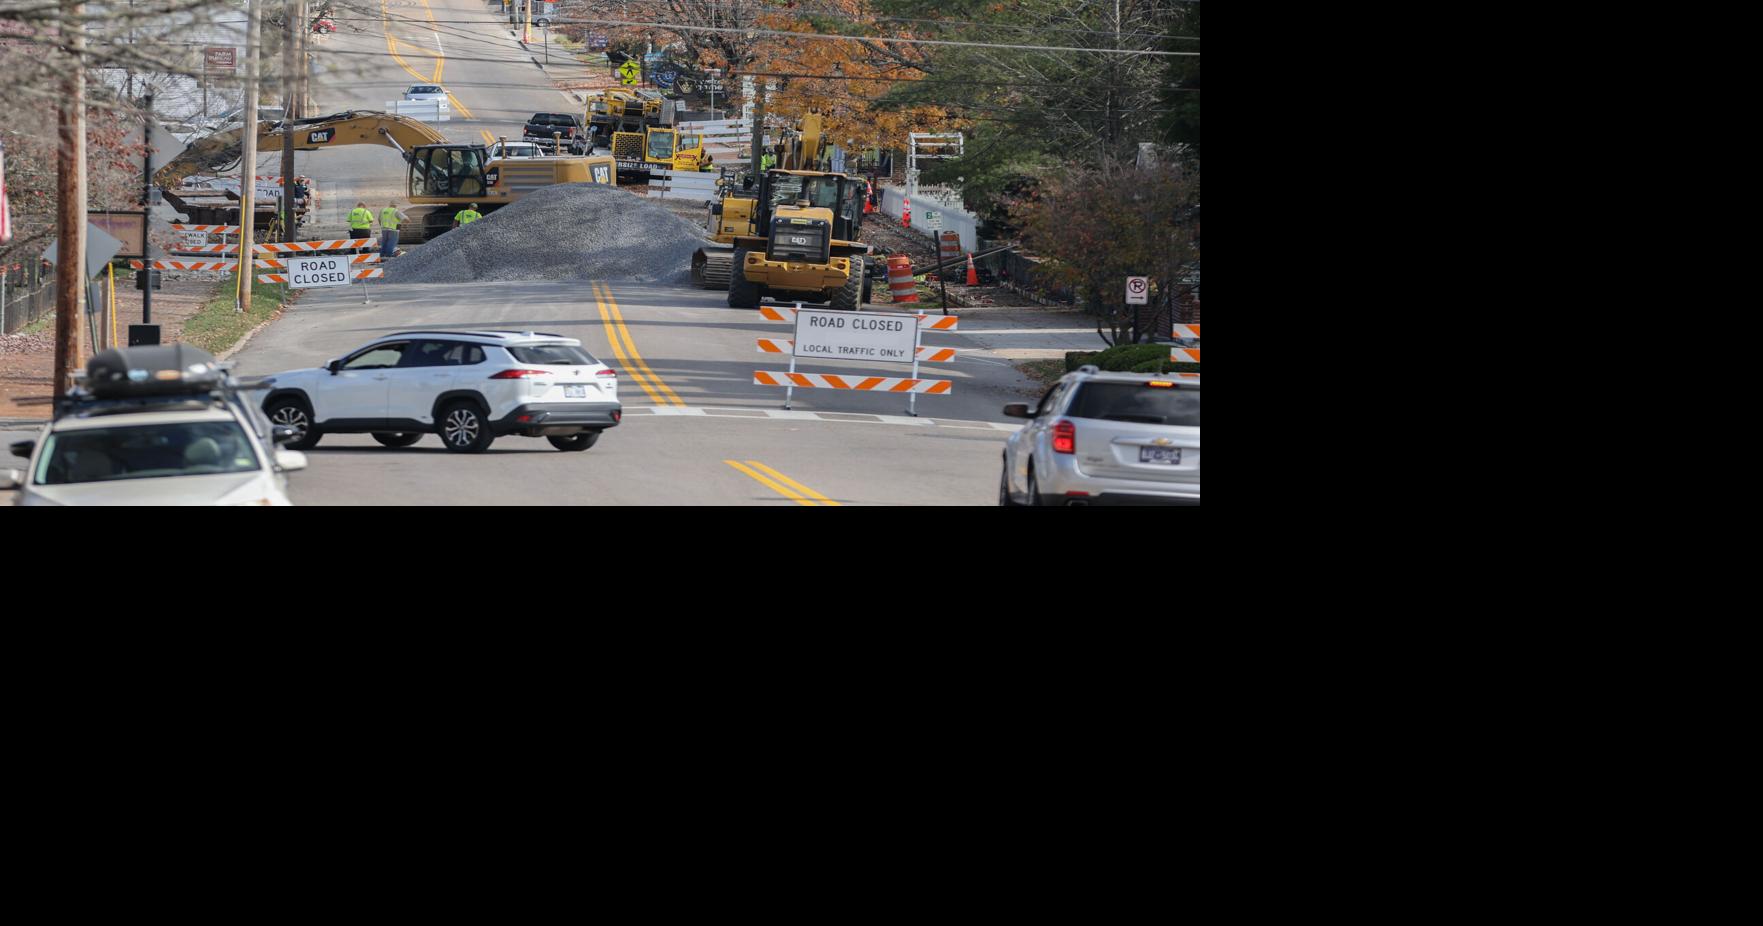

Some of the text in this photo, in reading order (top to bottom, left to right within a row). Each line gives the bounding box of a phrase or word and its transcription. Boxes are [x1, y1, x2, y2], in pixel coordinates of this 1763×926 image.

[311, 132, 328, 143] CAT
[594, 166, 609, 184] CAT
[301, 260, 336, 271] ROAD
[294, 272, 345, 284] CLOSED
[810, 316, 903, 332] ROAD CLOSED
[803, 344, 905, 357] LOCAL TRAFFIC ONLY
